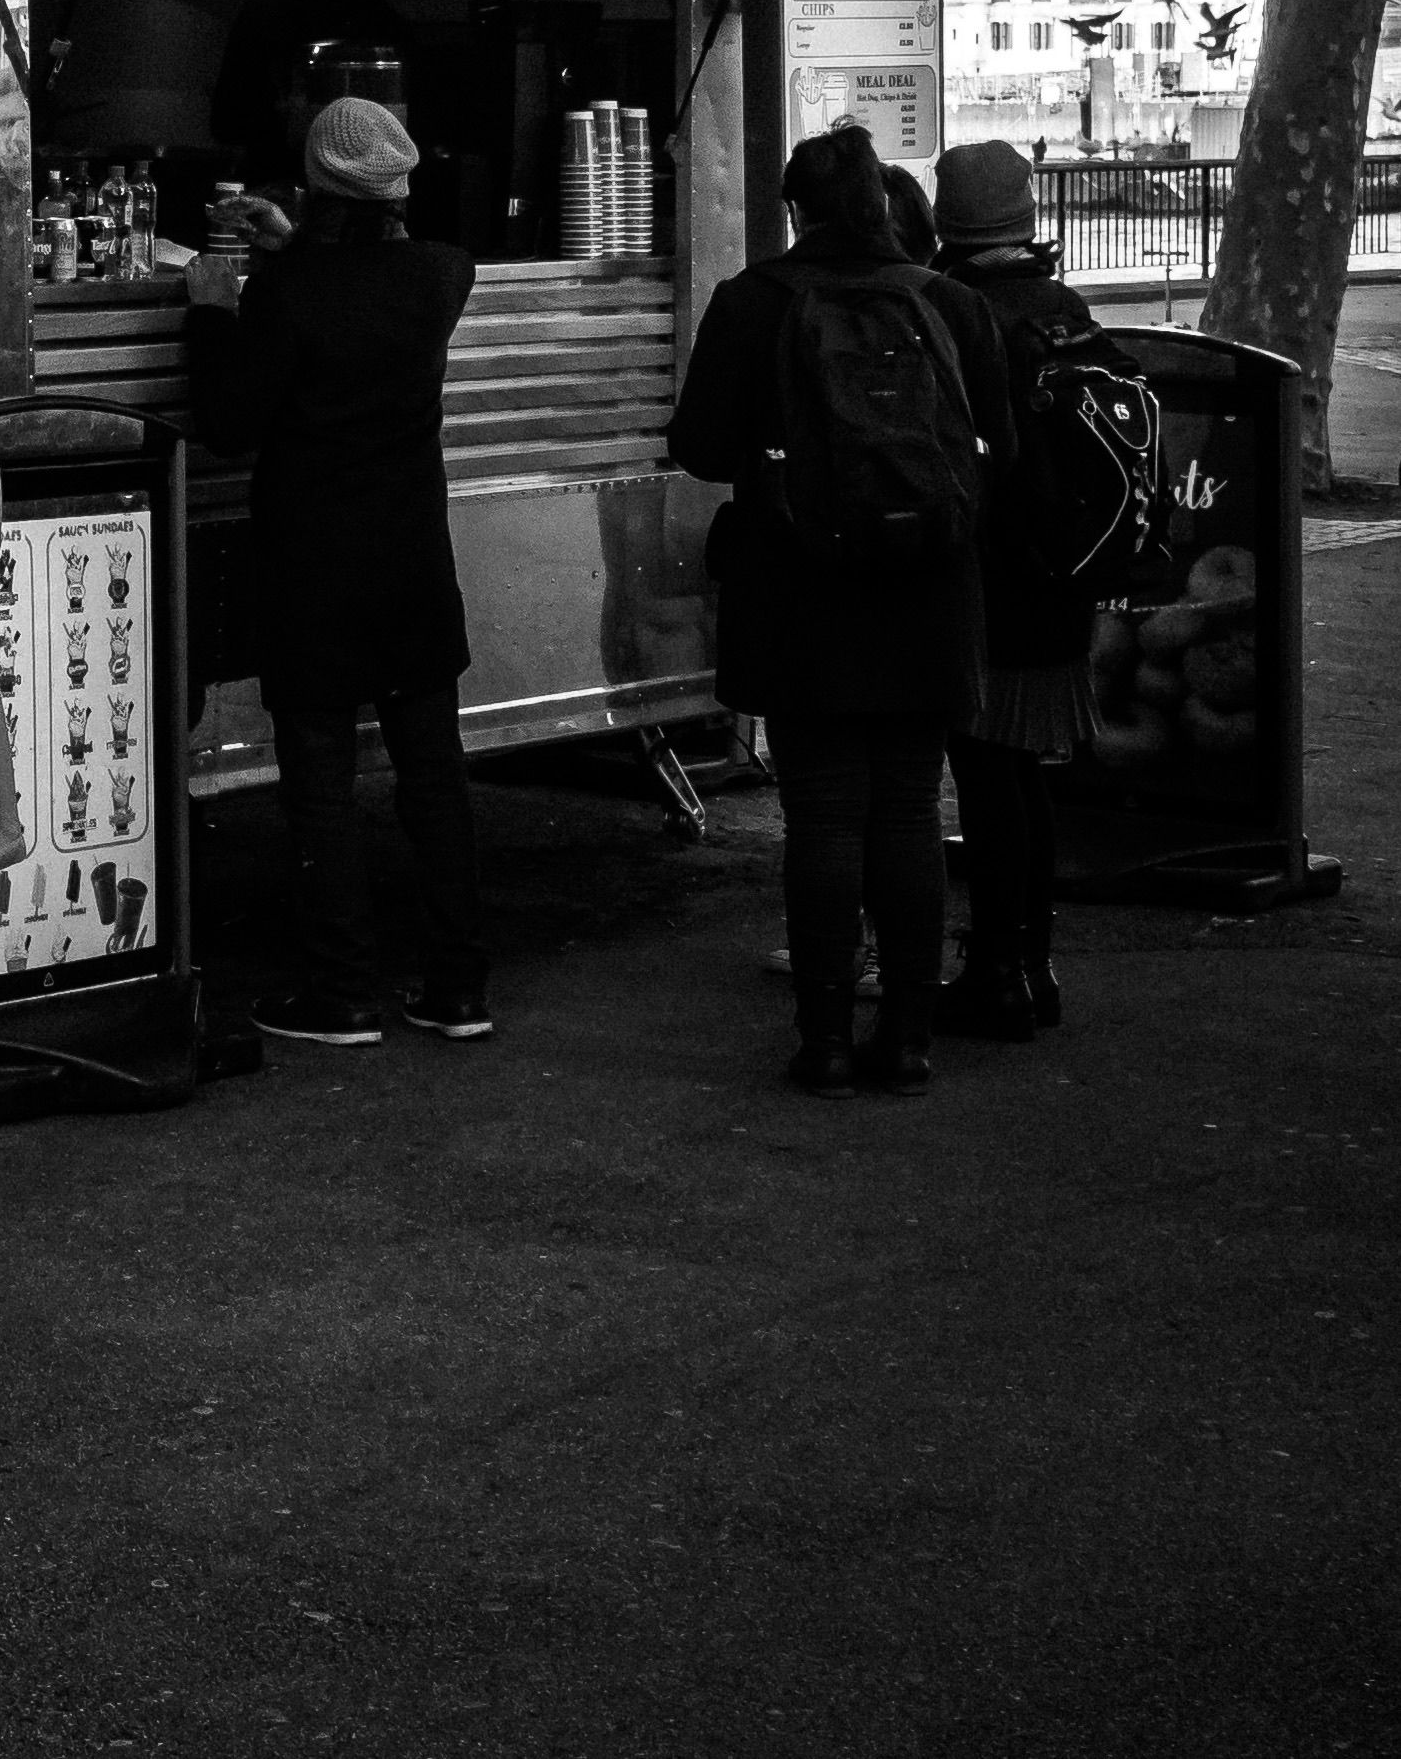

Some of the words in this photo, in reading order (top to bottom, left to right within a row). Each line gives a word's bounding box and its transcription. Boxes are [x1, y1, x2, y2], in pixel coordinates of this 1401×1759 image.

[801, 4, 834, 16] CHIPS
[856, 75, 886, 88] MEAL
[888, 74, 916, 87] DEAL
